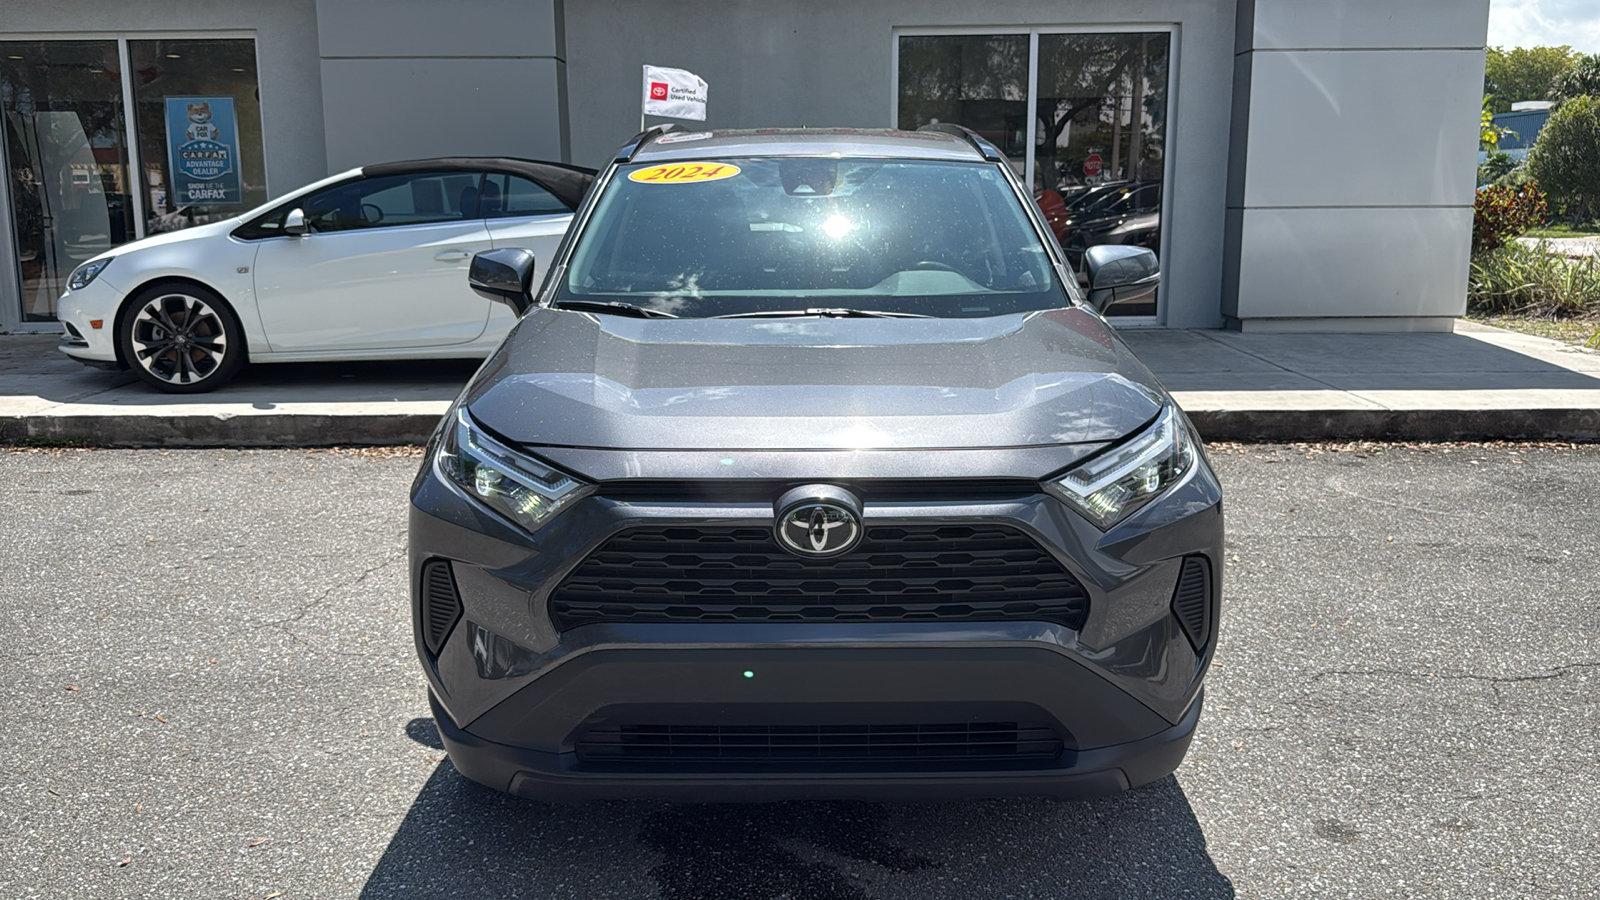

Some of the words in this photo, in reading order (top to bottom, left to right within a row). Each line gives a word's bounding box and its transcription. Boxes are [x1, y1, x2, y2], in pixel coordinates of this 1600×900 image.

[671, 87, 696, 95] Certified
[182, 151, 226, 159] CARFAX
[644, 166, 724, 180] 2024
[188, 190, 226, 199] CARFAX
